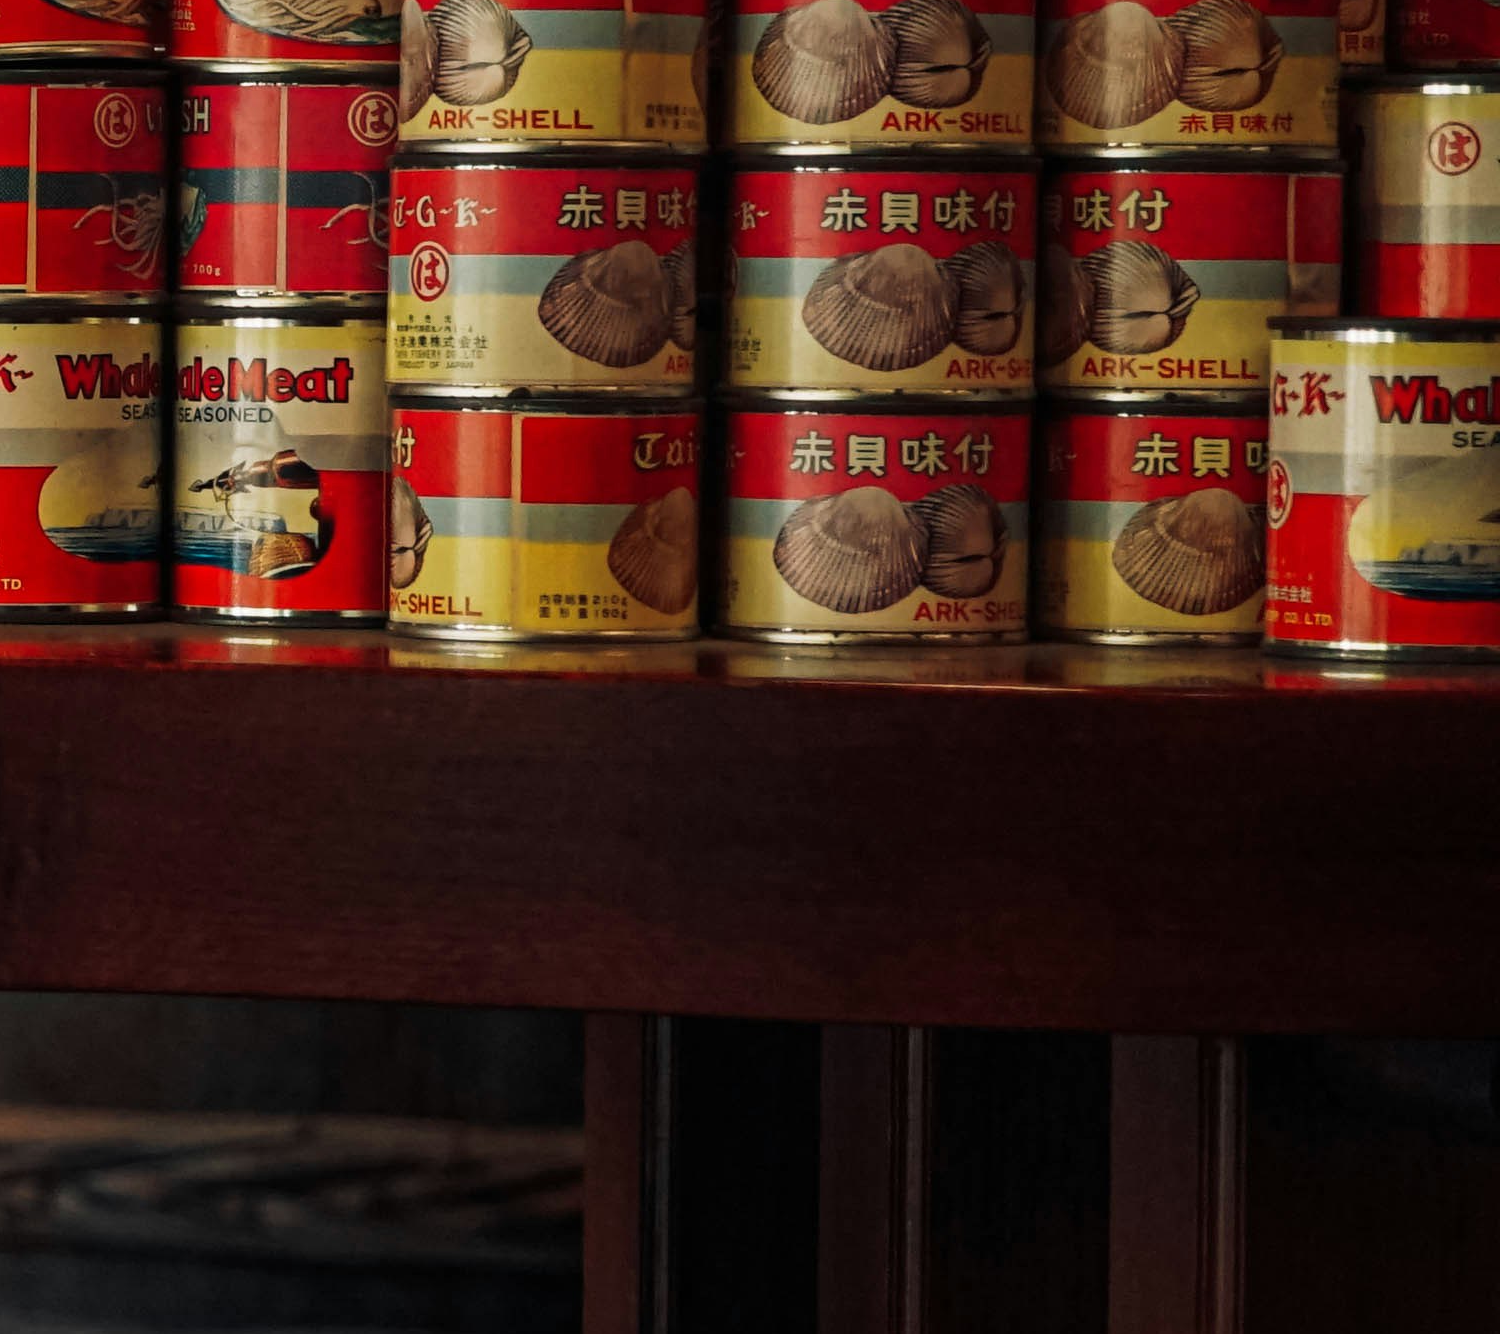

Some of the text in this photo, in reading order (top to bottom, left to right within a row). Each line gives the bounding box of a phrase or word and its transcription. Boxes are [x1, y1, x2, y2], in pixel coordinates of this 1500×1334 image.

[428, 108, 594, 130] ARK-SHELL
[881, 112, 1025, 135] ARK-SHELL
[1177, 112, 1294, 135] 赤貝味付
[820, 189, 1020, 235] 赤貝味付
[1082, 356, 1261, 380] ARK-SHELL
[227, 358, 355, 403] Meat
[178, 406, 275, 424] SEASONED
[790, 432, 995, 477] 赤貝味付
